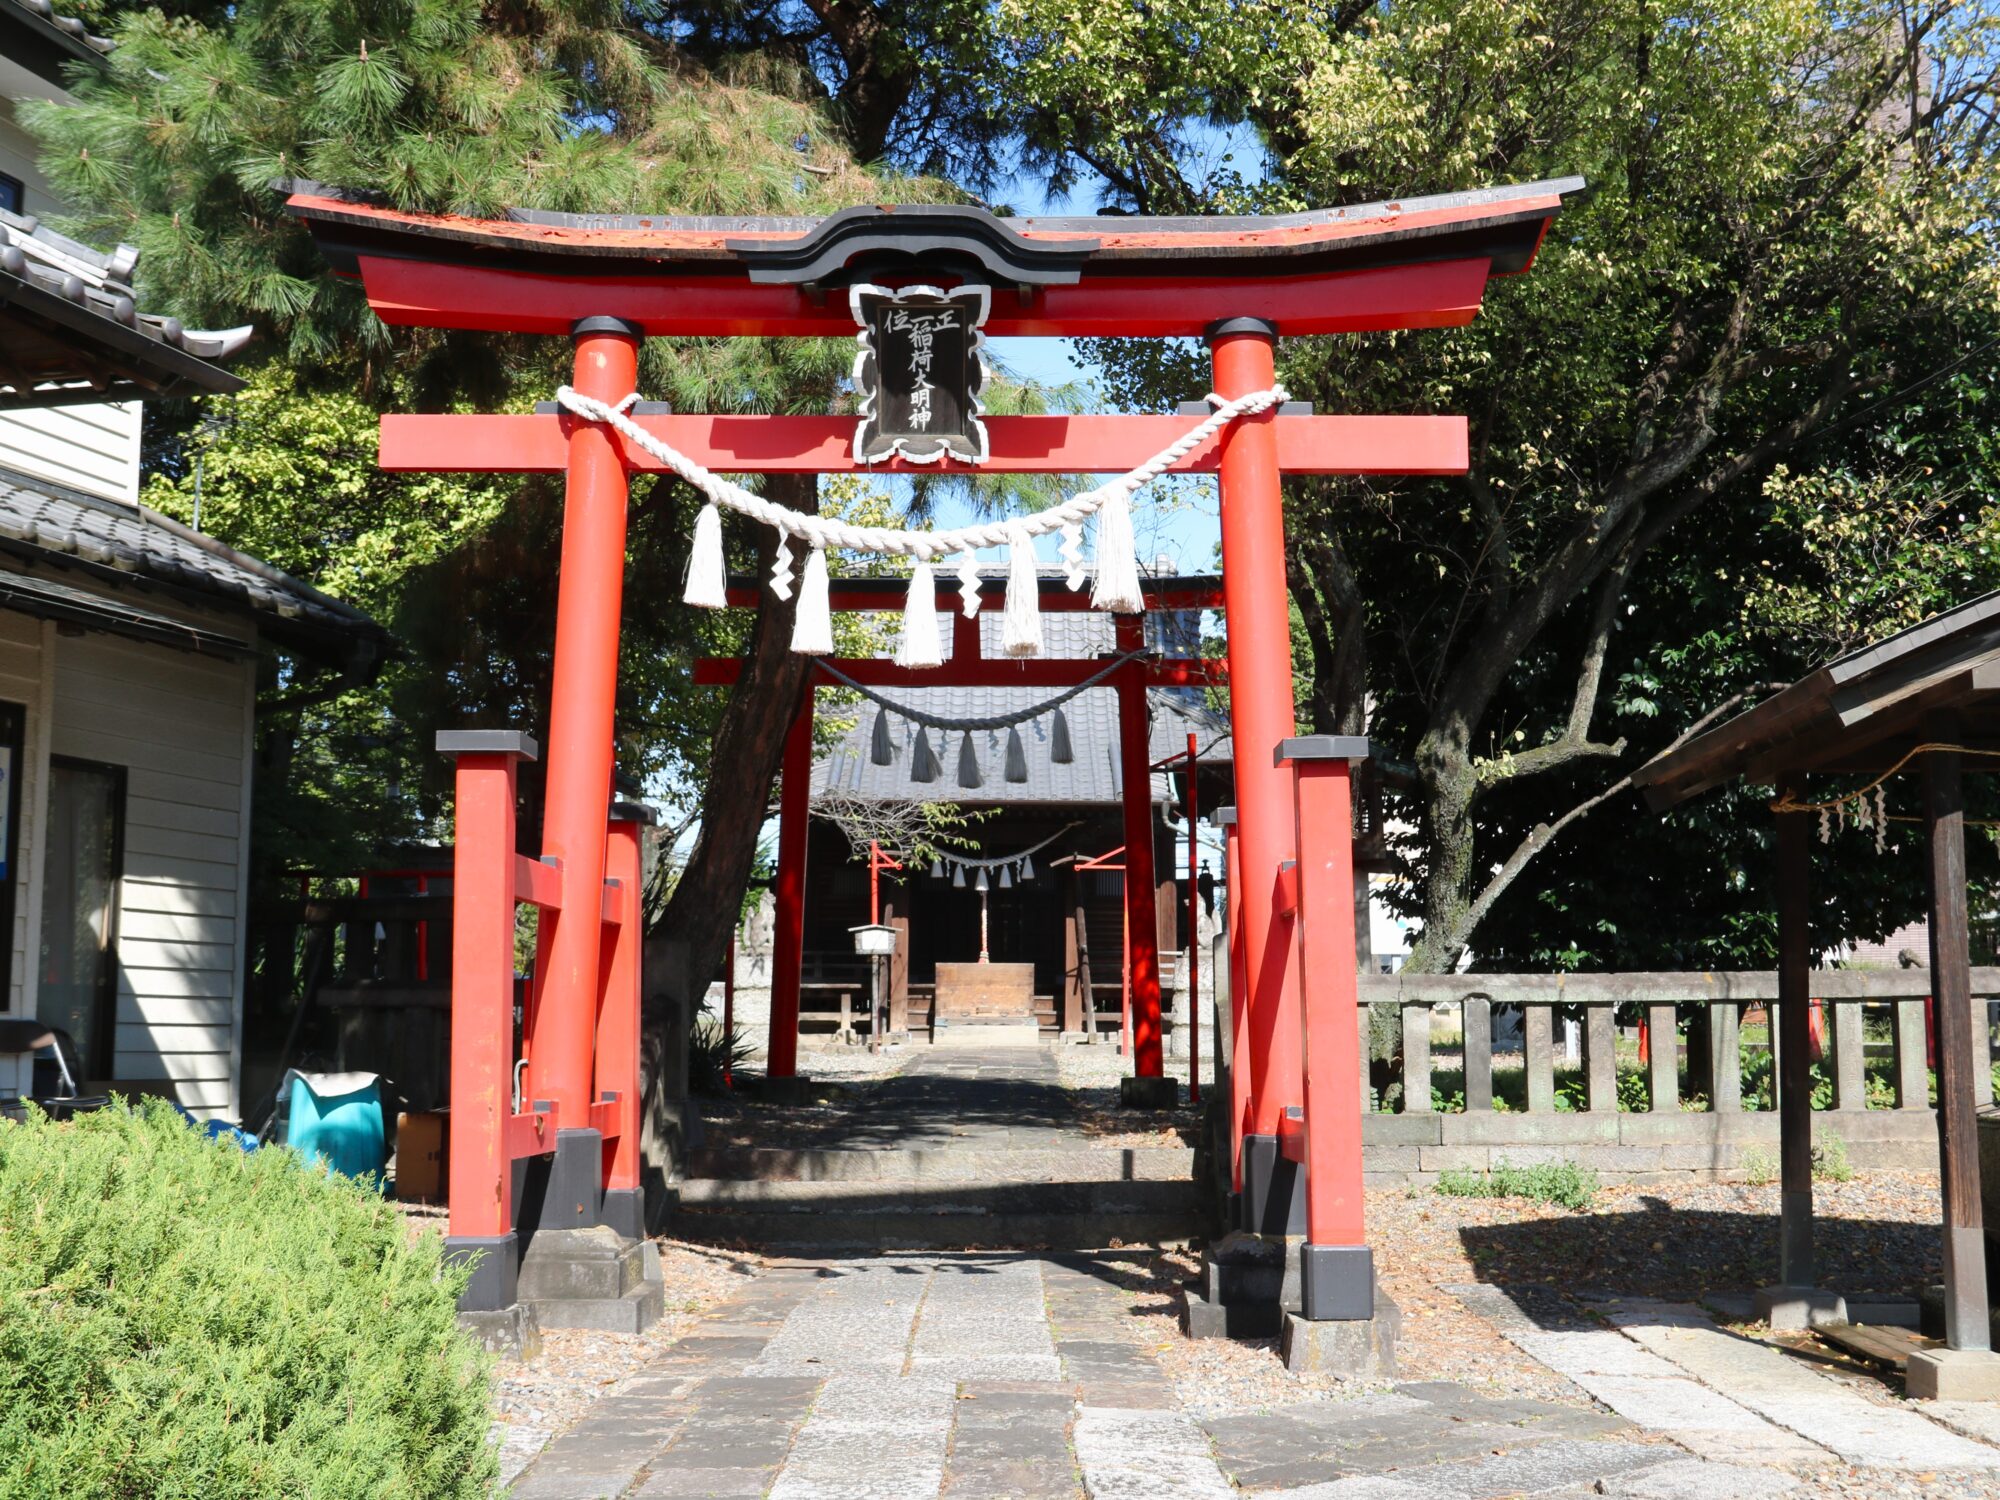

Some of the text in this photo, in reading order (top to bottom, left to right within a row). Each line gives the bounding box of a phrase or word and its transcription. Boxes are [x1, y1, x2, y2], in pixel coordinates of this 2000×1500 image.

[907, 324, 936, 432] 稲荷大明神
